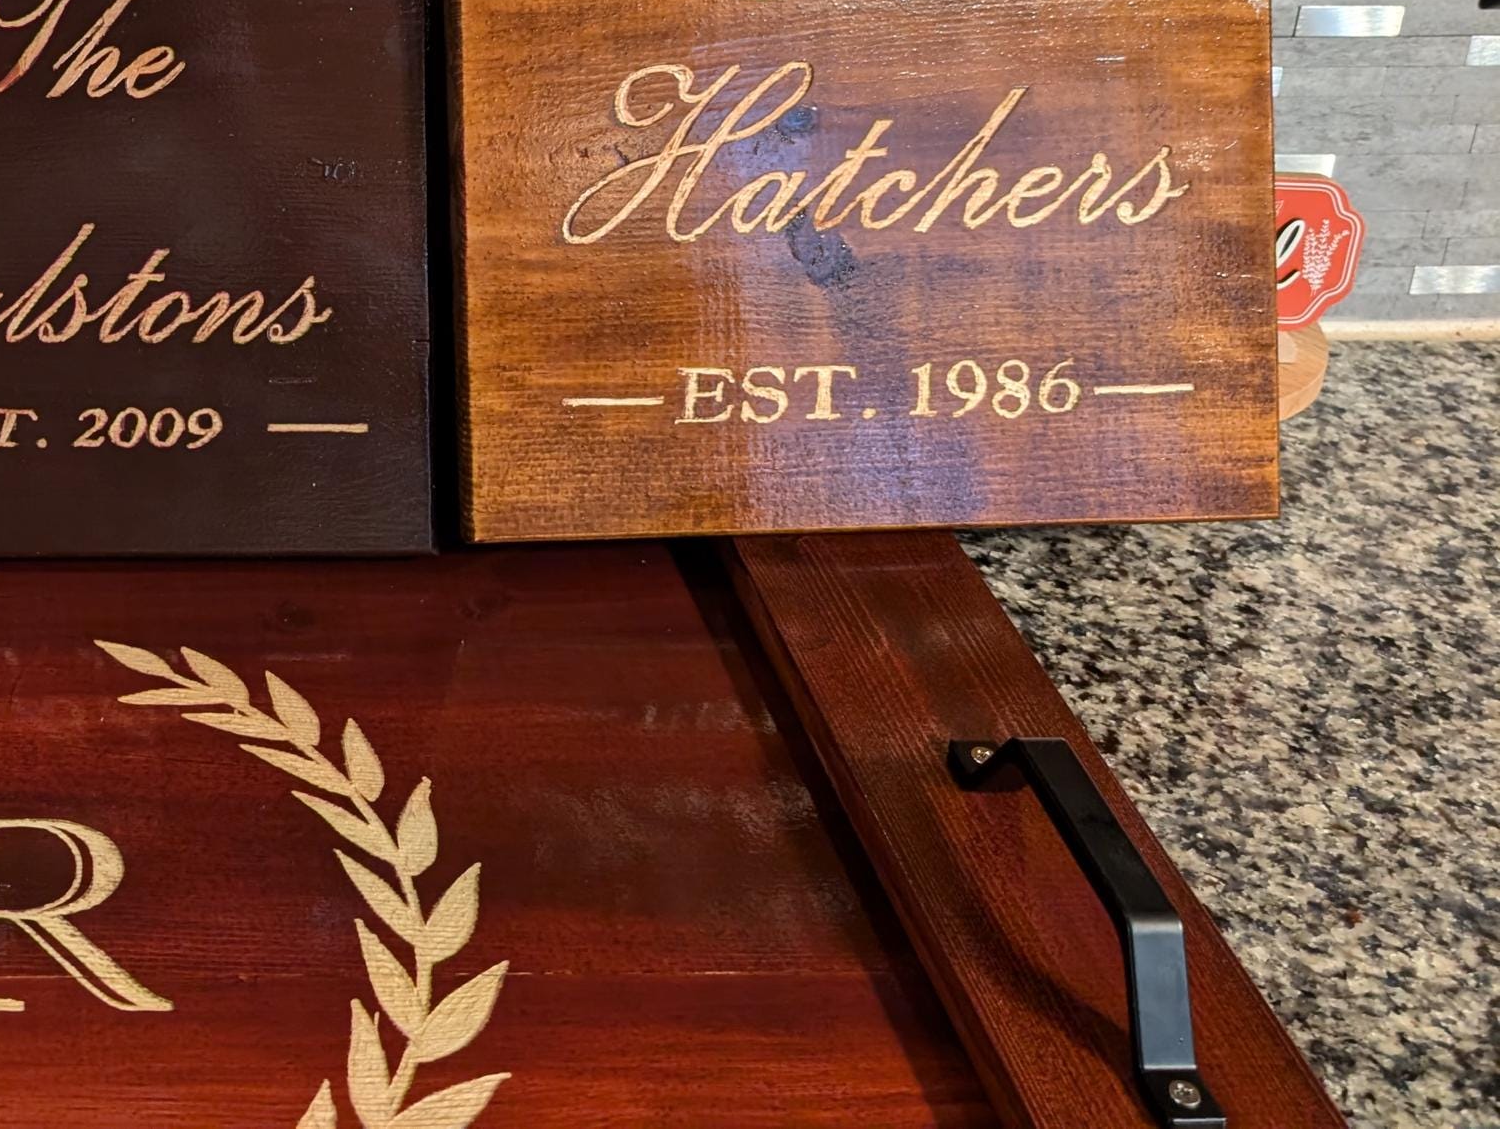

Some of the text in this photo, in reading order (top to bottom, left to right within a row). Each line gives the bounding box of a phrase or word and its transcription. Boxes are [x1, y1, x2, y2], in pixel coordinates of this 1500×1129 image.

[562, 59, 1191, 246] Hatchers
[672, 357, 1083, 427] EST. 1986
[71, 406, 224, 450] 2009
